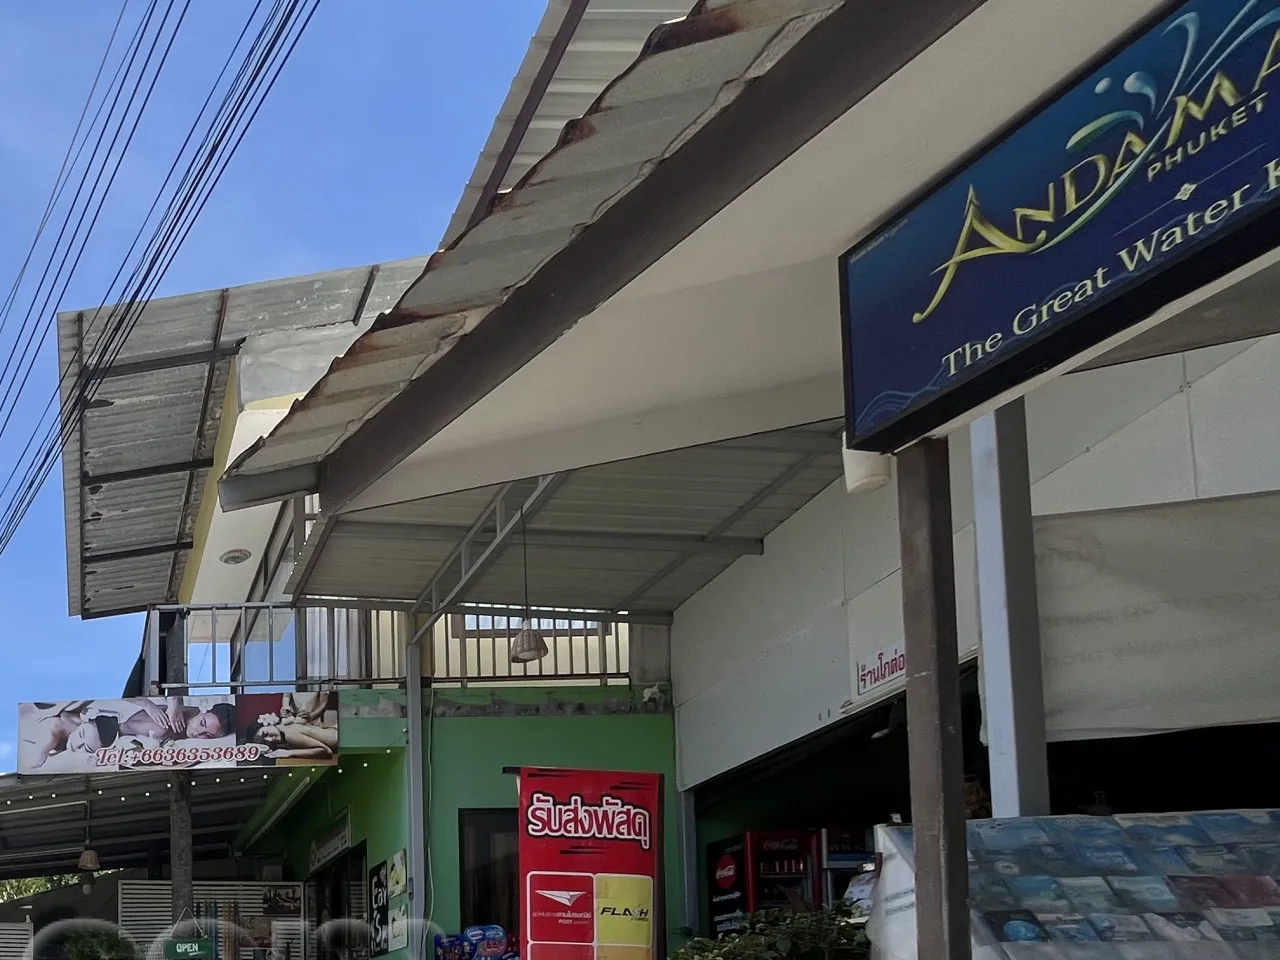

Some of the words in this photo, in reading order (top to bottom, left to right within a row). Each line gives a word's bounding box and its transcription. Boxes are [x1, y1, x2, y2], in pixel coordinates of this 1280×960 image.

[1147, 91, 1268, 183] PHUKET
[941, 331, 1003, 378] The
[1012, 265, 1112, 336] Great
[1117, 183, 1251, 275] Water
[527, 793, 650, 849] รับส่งพัสดุ
[176, 942, 199, 953] OPEN
